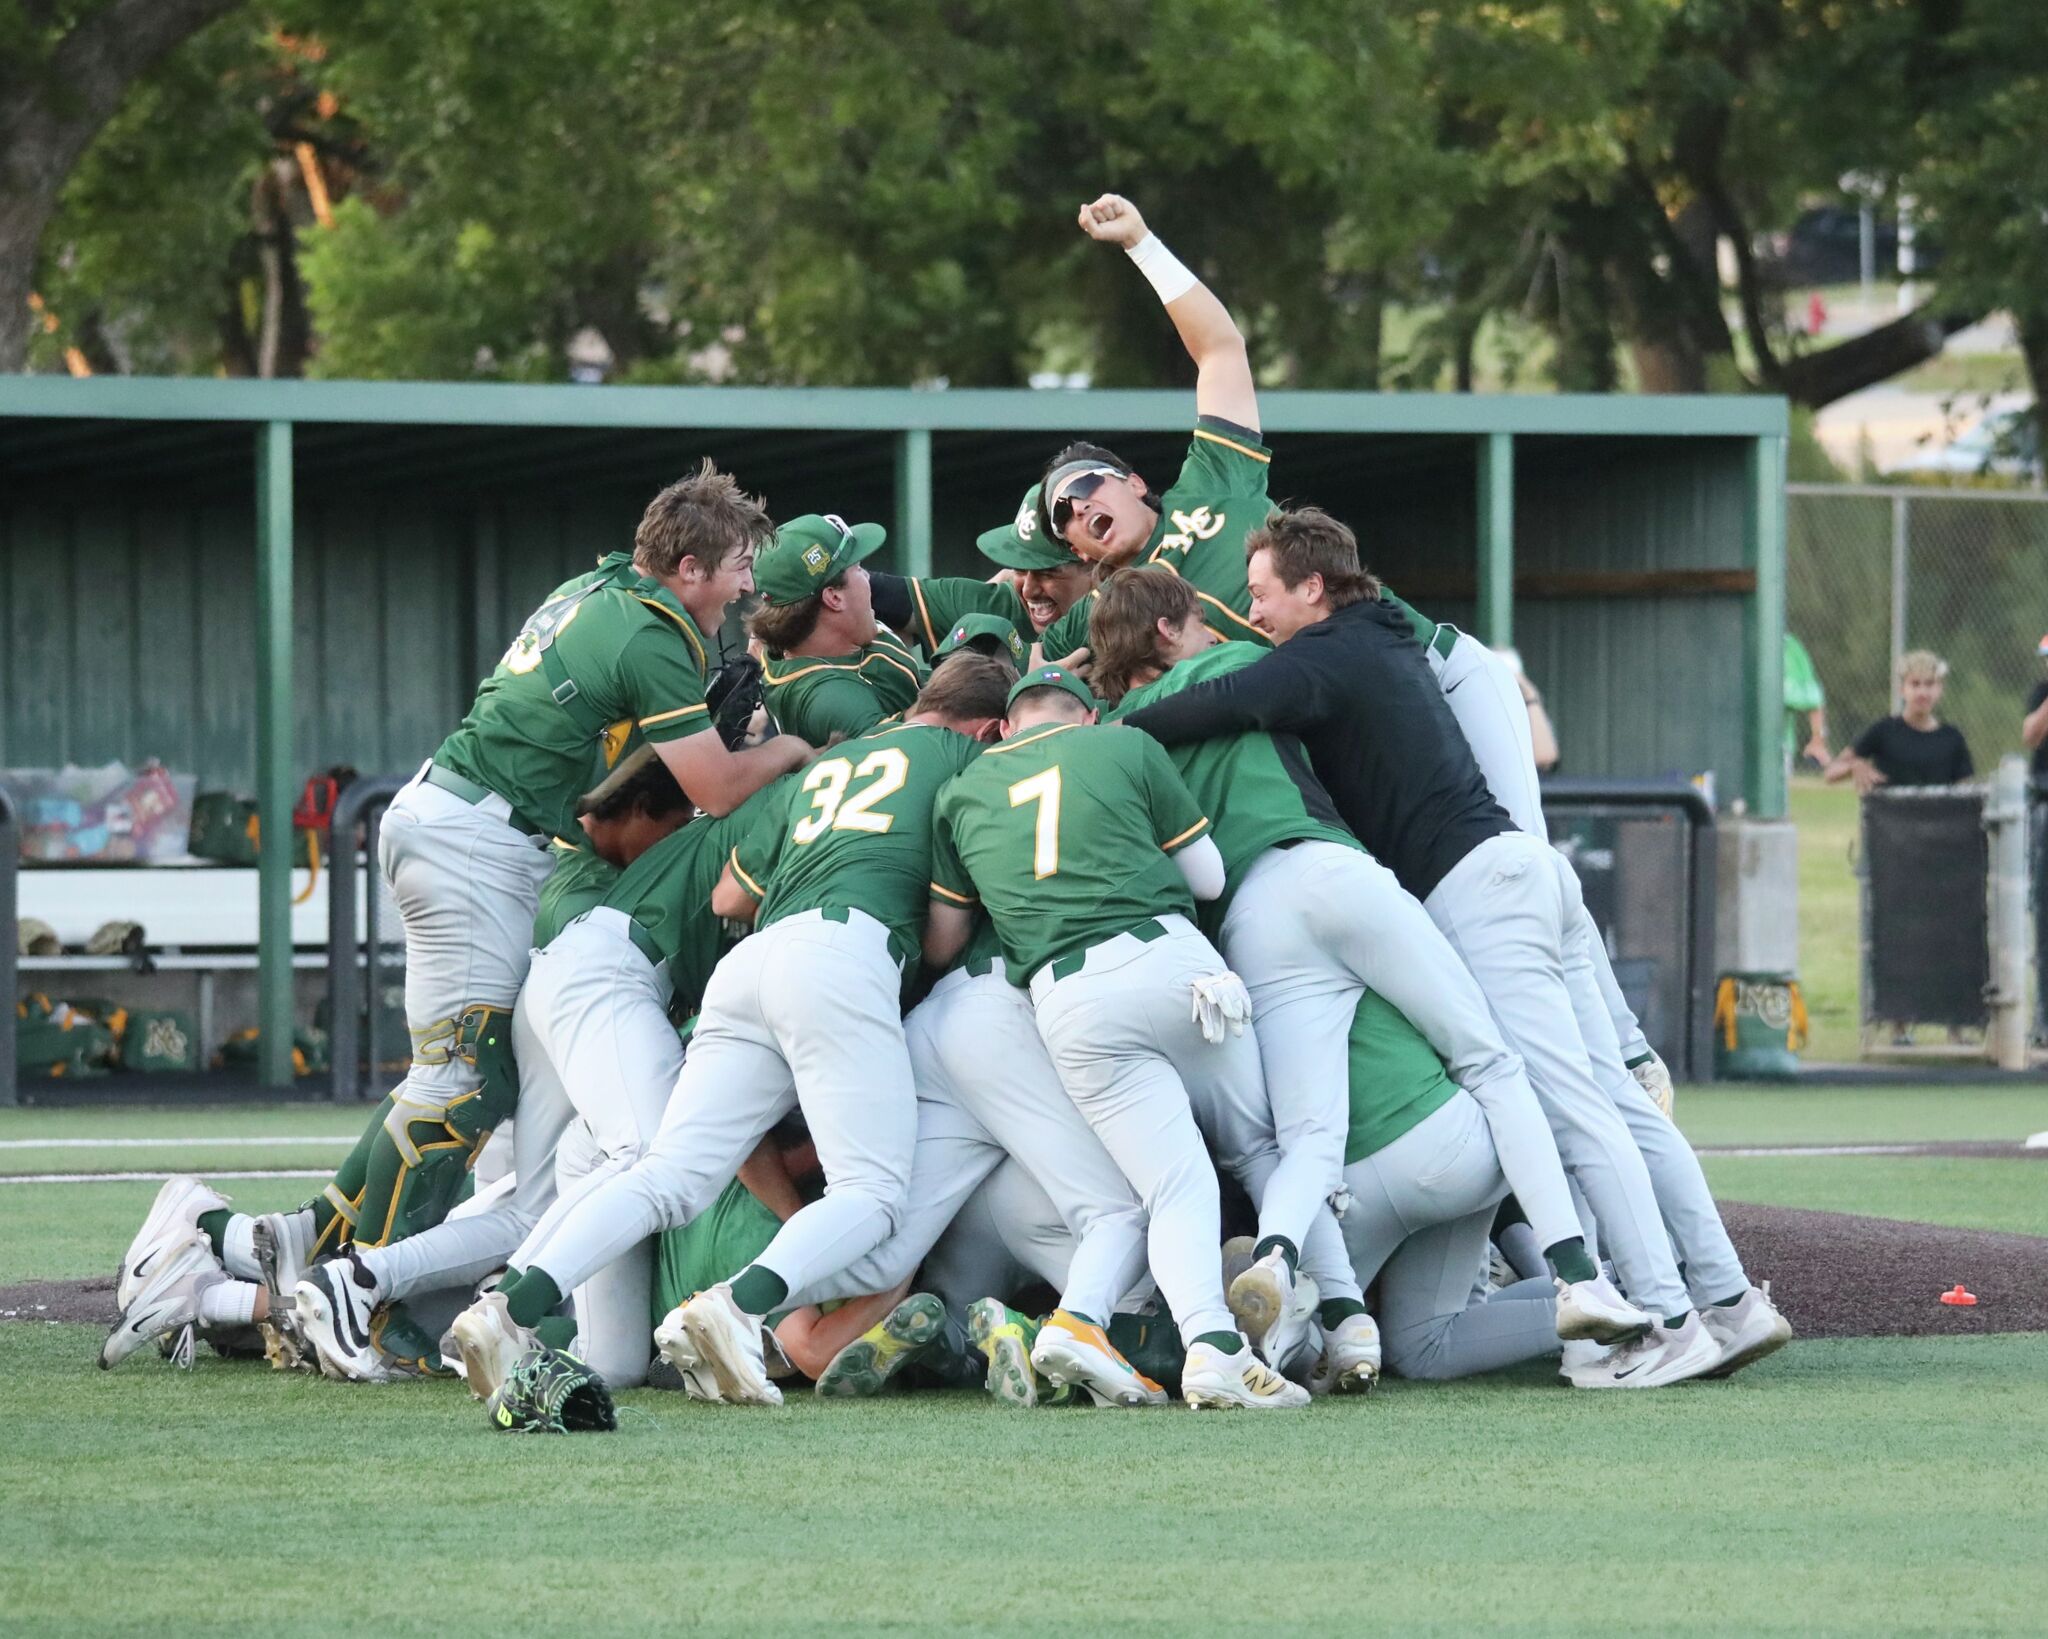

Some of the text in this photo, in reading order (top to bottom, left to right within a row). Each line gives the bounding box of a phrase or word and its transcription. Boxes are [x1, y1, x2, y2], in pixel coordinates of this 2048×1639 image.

[807, 547, 822, 565] 25
[792, 747, 910, 844] 32
[1008, 765, 1061, 880] 7
